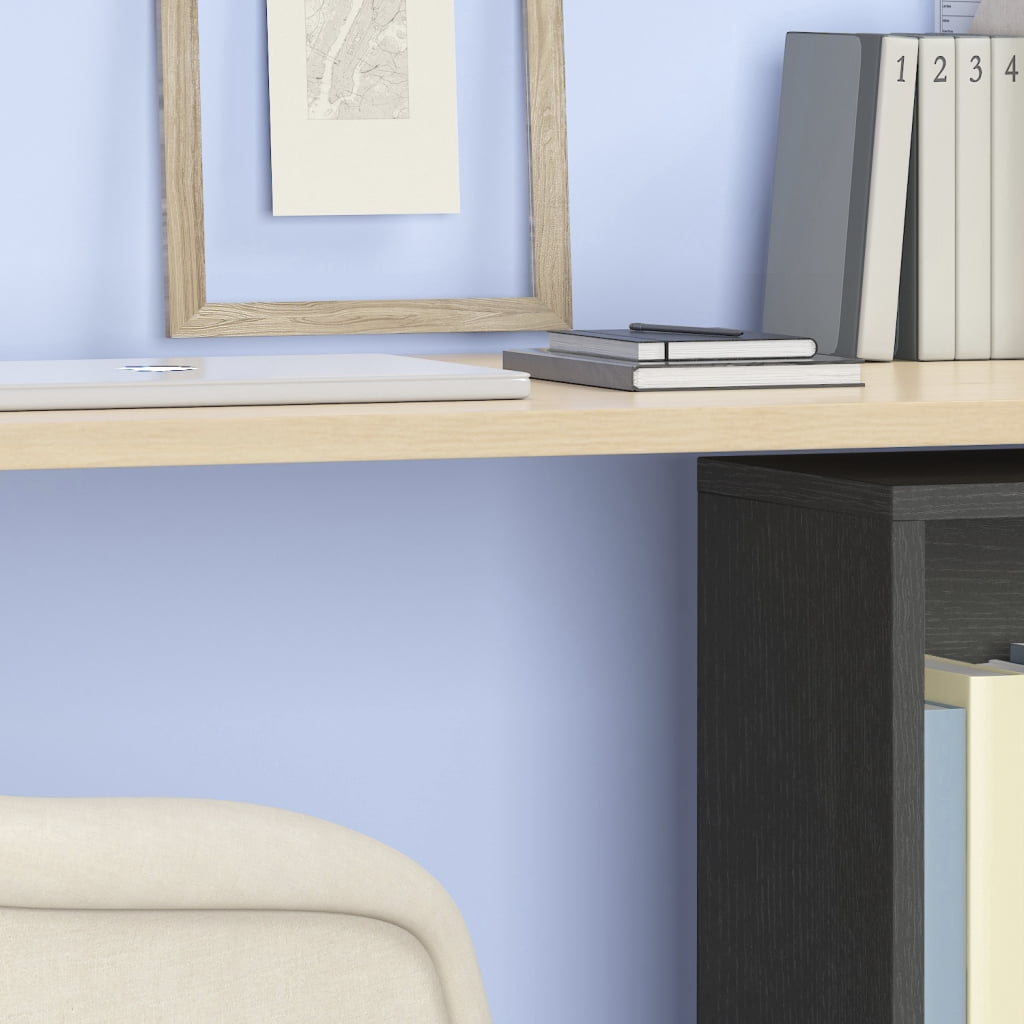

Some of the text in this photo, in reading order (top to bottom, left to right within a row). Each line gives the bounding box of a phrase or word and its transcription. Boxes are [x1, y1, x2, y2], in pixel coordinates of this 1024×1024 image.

[896, 55, 905, 83] 1
[933, 55, 947, 83] 2
[969, 55, 982, 83] 3
[1004, 54, 1019, 83] 4
